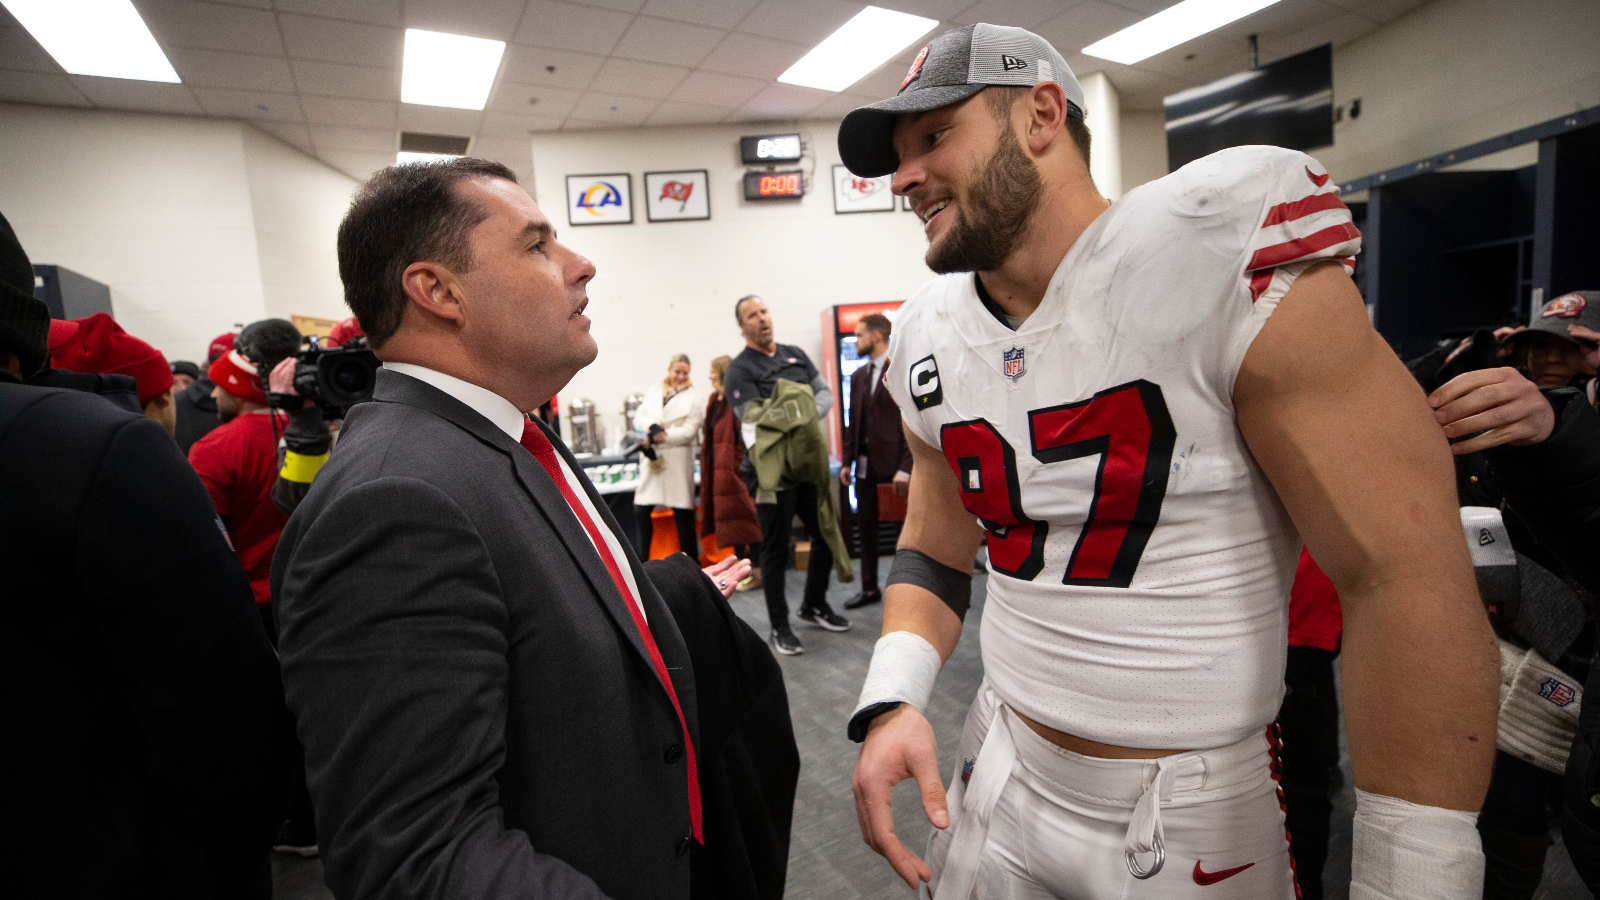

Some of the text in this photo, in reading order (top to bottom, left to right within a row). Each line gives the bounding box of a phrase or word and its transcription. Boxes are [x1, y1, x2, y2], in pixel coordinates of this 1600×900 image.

[760, 175, 799, 195] 0:00
[1005, 359, 1023, 375] NFL
[910, 358, 938, 397] C
[940, 378, 1177, 588] 97
[1550, 686, 1573, 705] NFL
